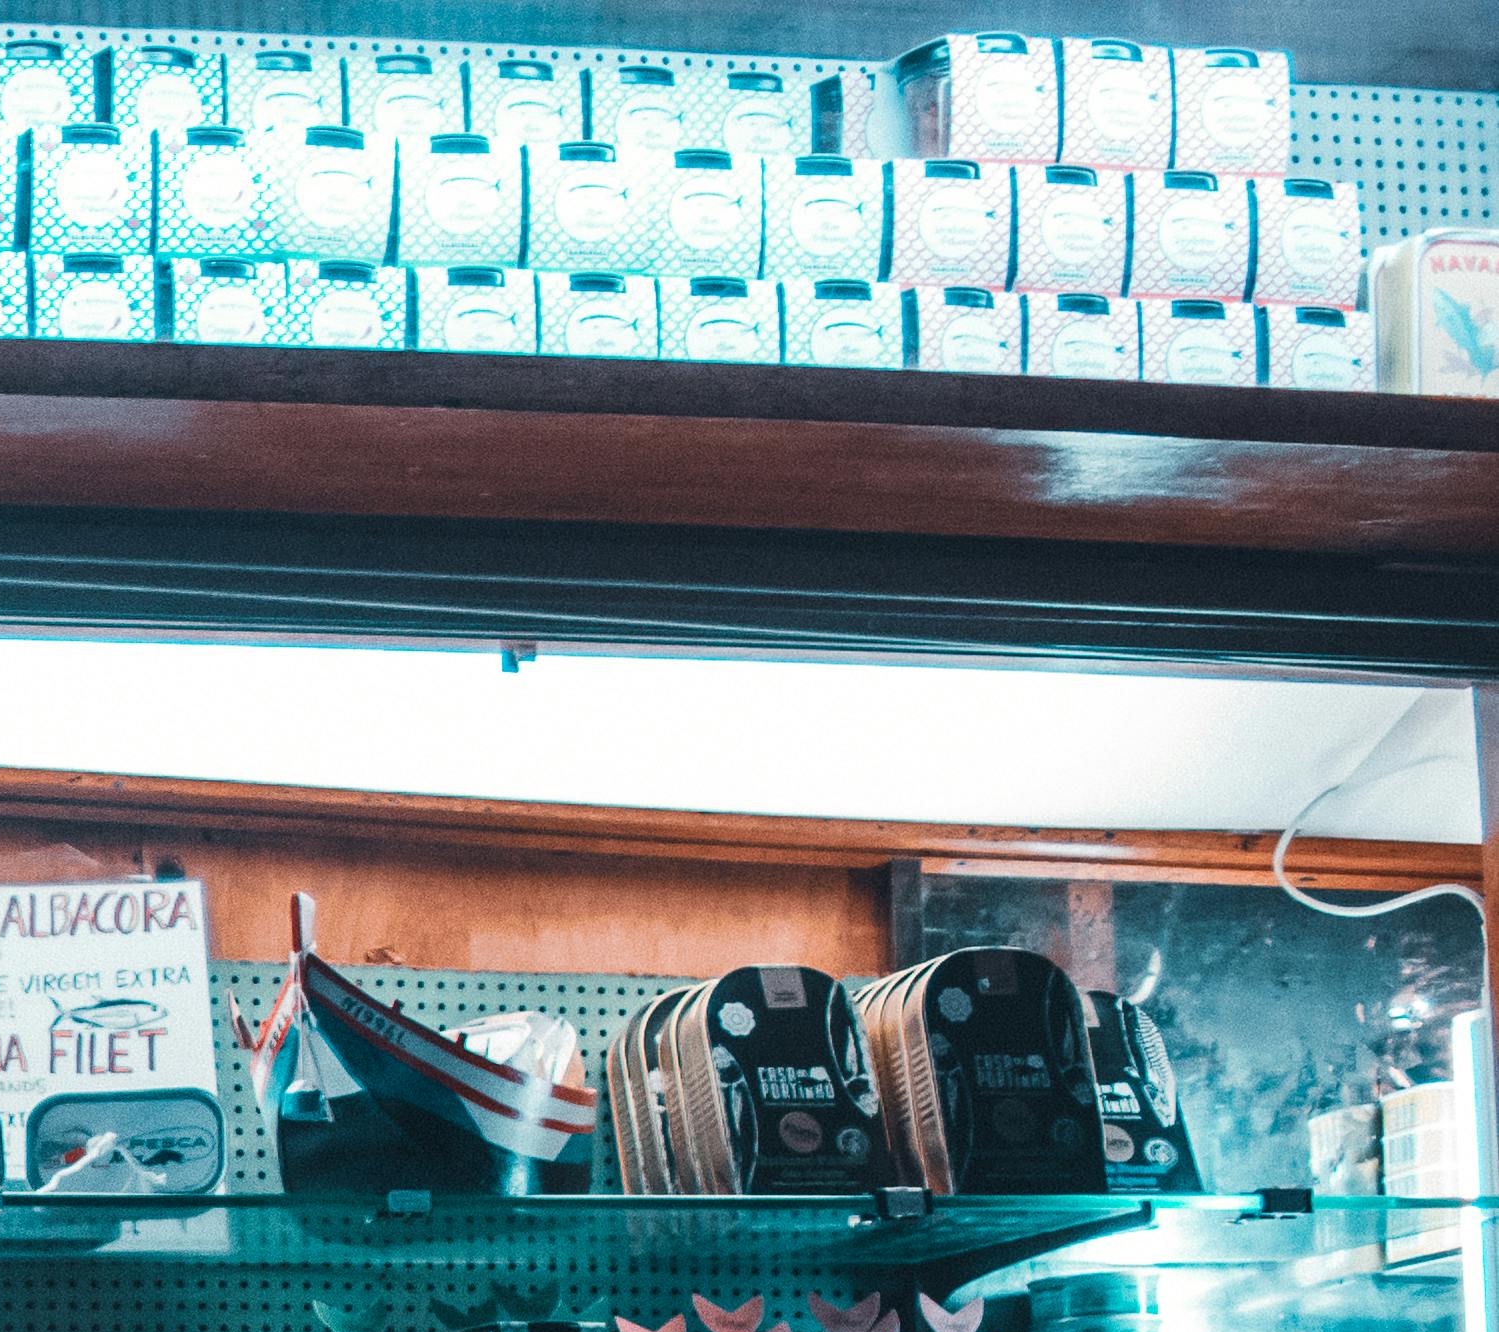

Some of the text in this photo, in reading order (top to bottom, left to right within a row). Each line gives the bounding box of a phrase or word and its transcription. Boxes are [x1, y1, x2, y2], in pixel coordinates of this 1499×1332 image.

[0, 890, 198, 938] ALBACORA
[19, 971, 102, 994] VIRGEM
[115, 966, 191, 987] EXTRA
[50, 1027, 168, 1076] FILET
